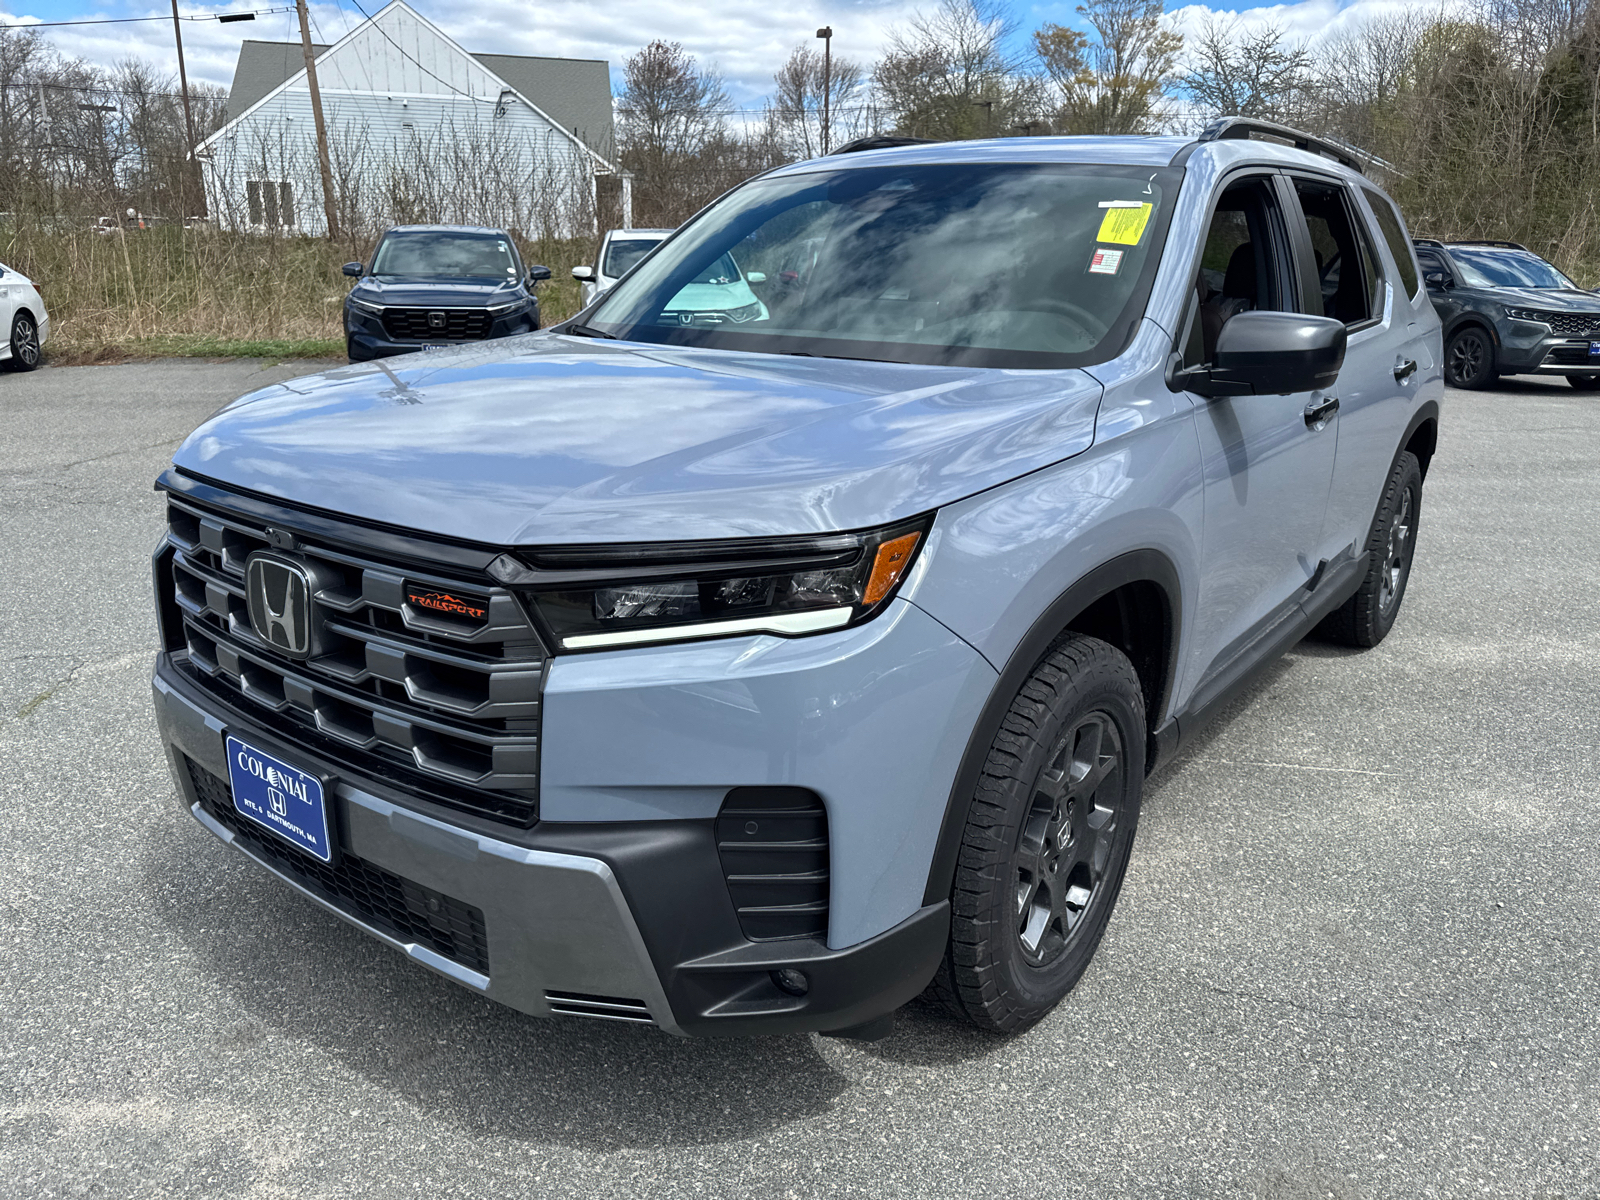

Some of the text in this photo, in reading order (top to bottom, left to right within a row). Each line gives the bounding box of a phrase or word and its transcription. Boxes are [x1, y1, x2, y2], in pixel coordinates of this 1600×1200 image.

[408, 594, 486, 618] TRAILSPORT
[243, 798, 258, 811] RTE.
[306, 832, 317, 845] MA
